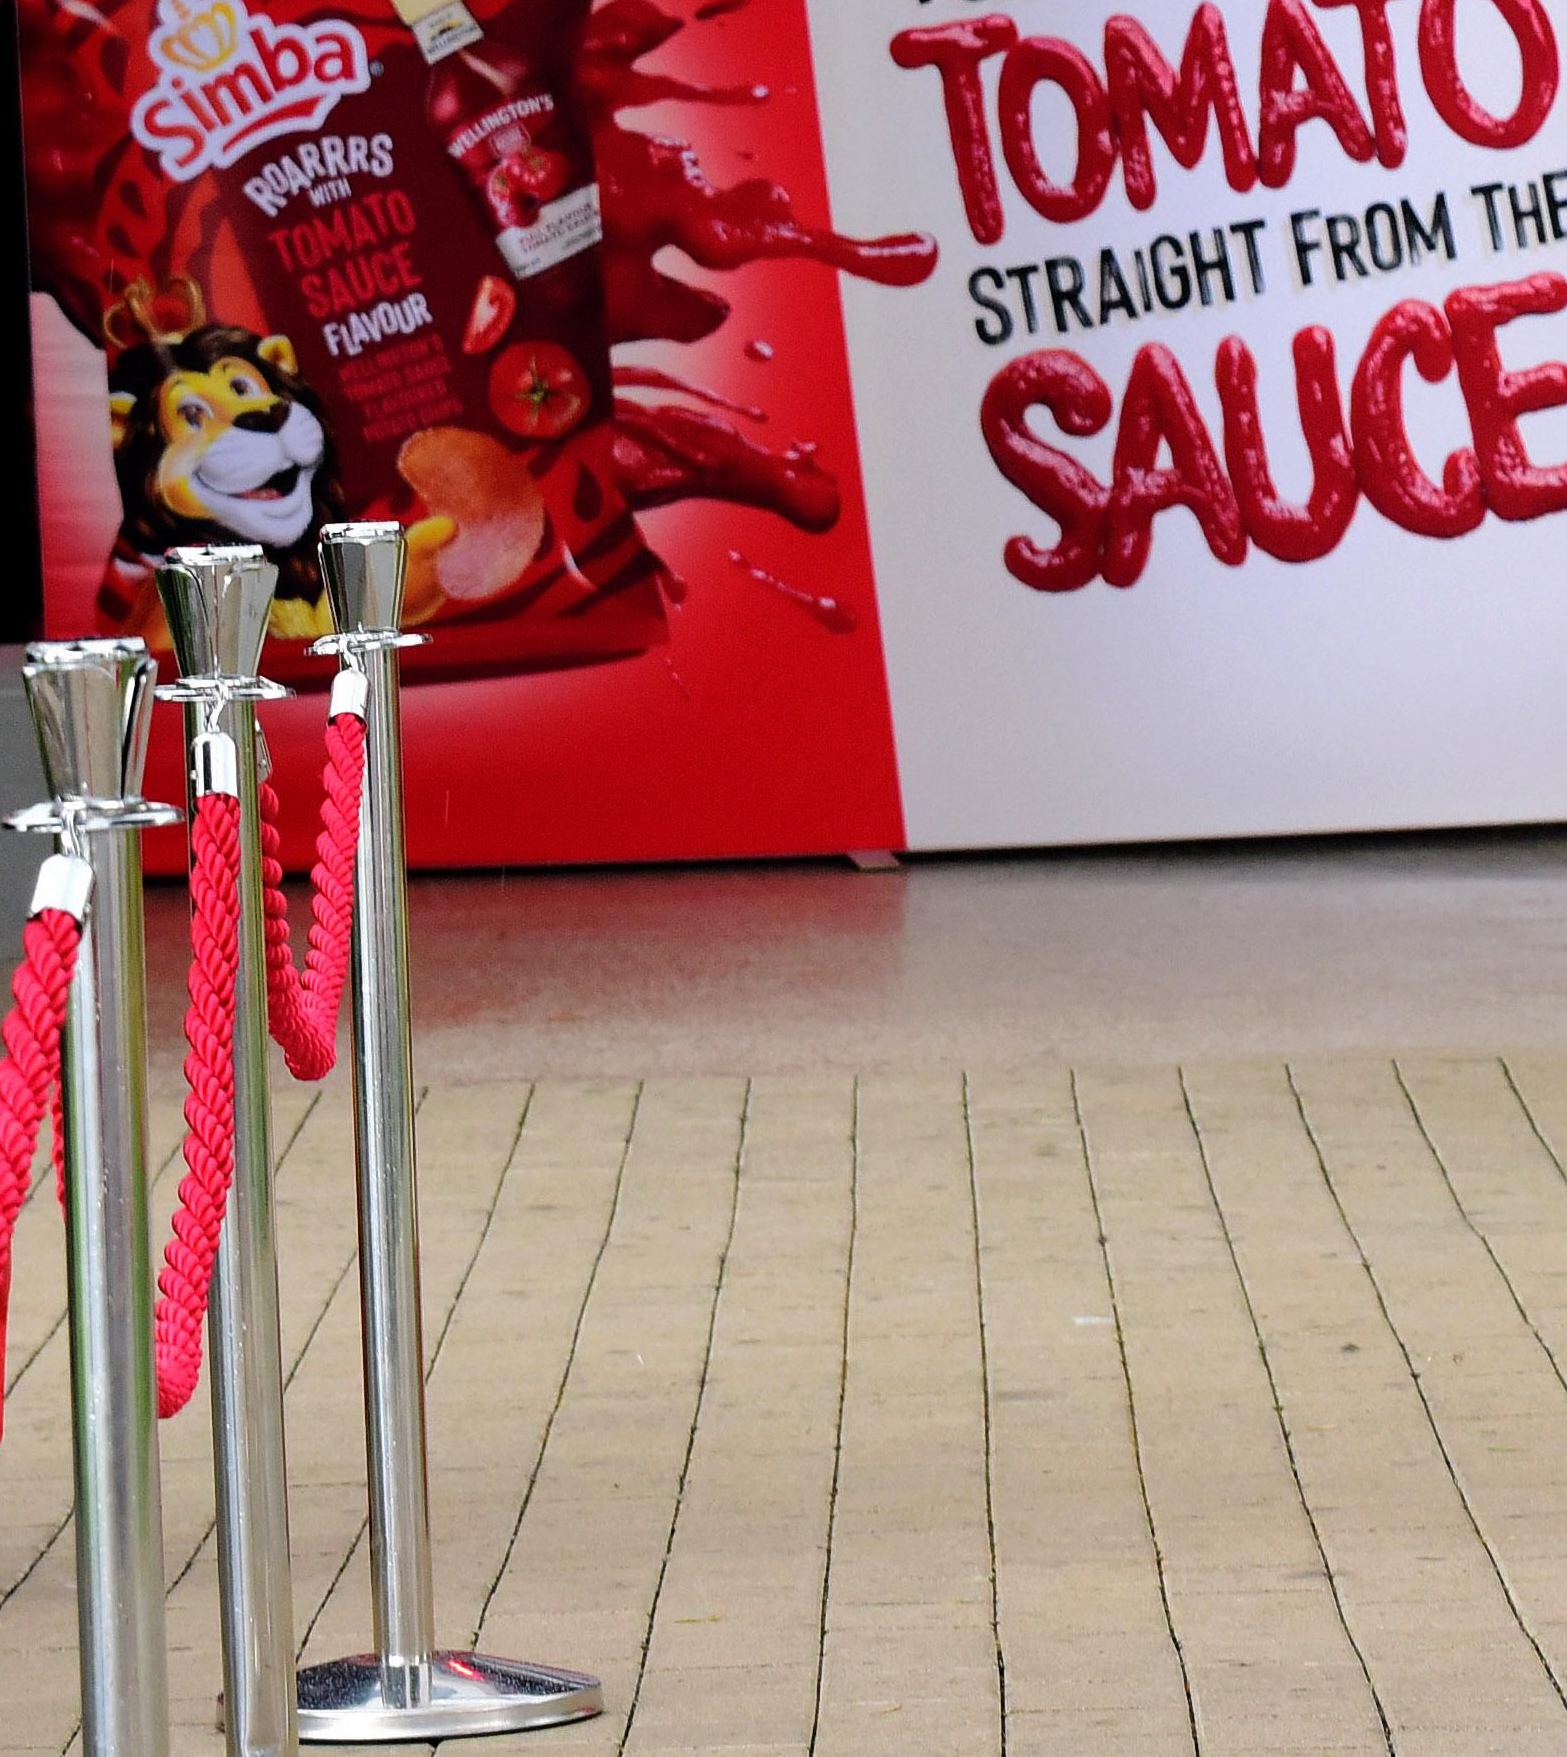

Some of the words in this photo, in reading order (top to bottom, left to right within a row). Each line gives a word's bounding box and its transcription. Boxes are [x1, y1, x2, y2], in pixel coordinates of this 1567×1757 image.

[143, 27, 357, 168] Simba
[242, 132, 393, 218] ROARRRS
[308, 177, 352, 208] WITH
[268, 189, 417, 273] TOMATO
[967, 219, 1266, 344] STRAIGHT
[1291, 192, 1458, 287] FROM
[300, 241, 423, 319] SAUCE
[322, 292, 434, 357] FLAVOUR
